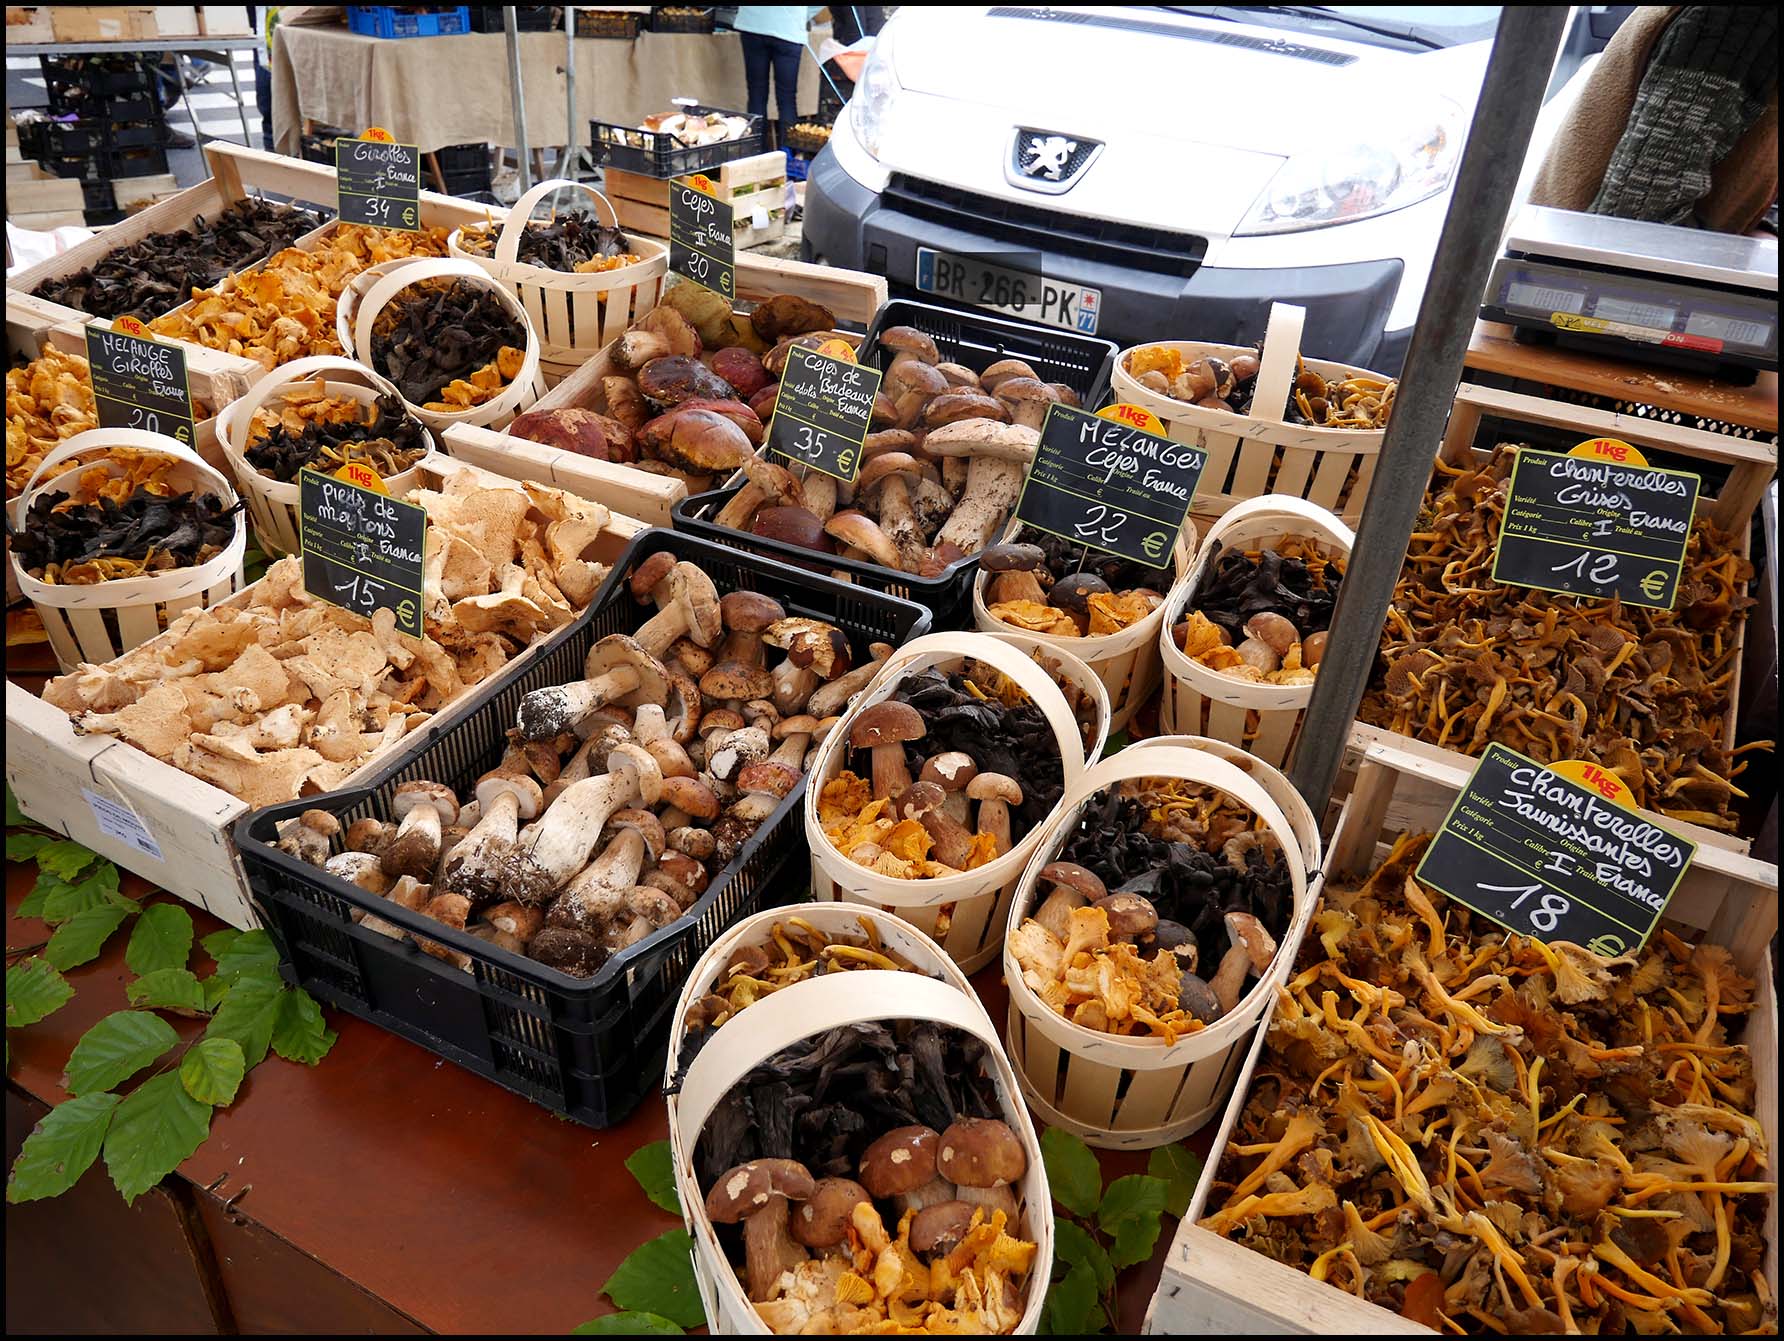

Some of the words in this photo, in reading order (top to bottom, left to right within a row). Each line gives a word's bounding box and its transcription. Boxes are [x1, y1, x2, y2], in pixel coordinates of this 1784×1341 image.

[368, 129, 385, 141] 1kg
[694, 175, 708, 191] 1kg
[365, 198, 390, 218] 34
[688, 252, 709, 278] 20
[120, 318, 140, 335] 1kg
[842, 366, 862, 386] de
[820, 378, 875, 407] Bordeaux
[1118, 405, 1150, 427] 1kg
[793, 427, 827, 458] 35
[836, 448, 855, 473] €
[1594, 441, 1629, 461] 1kg
[347, 467, 372, 487] 1kg
[1142, 469, 1190, 501] France
[374, 495, 399, 521] de
[1074, 505, 1127, 542] 22
[1141, 531, 1167, 558] €
[1551, 551, 1620, 584] 12
[1639, 570, 1669, 600] €
[335, 575, 386, 606] 15
[396, 600, 416, 628] €
[1491, 751, 1519, 770] Produit
[1583, 765, 1622, 800] 1kg
[1469, 791, 1495, 809] Variété
[1451, 819, 1468, 832] Prix
[1460, 805, 1495, 828] Catégorie
[1523, 838, 1551, 856] Calibre
[1559, 838, 1589, 858] Origine
[1476, 882, 1571, 932] 18
